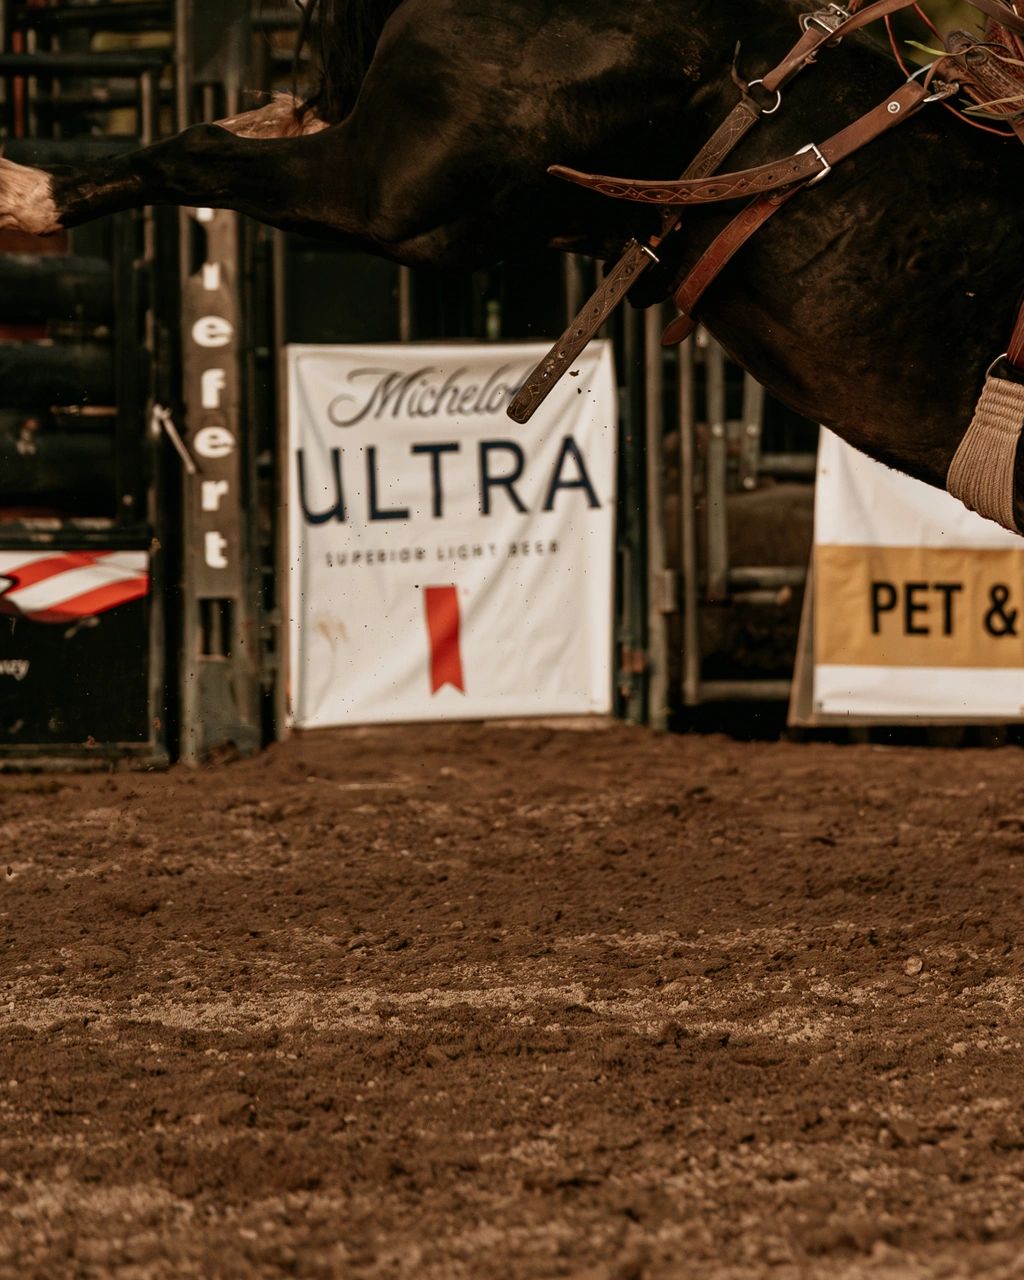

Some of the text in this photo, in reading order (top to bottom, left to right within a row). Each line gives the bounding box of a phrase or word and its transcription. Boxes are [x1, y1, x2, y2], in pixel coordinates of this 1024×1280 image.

[296, 433, 602, 526] ULTRA
[325, 538, 560, 567] SUPERIOR LIGHT BEER
[870, 581, 965, 637] PET
[984, 582, 1018, 639] &
